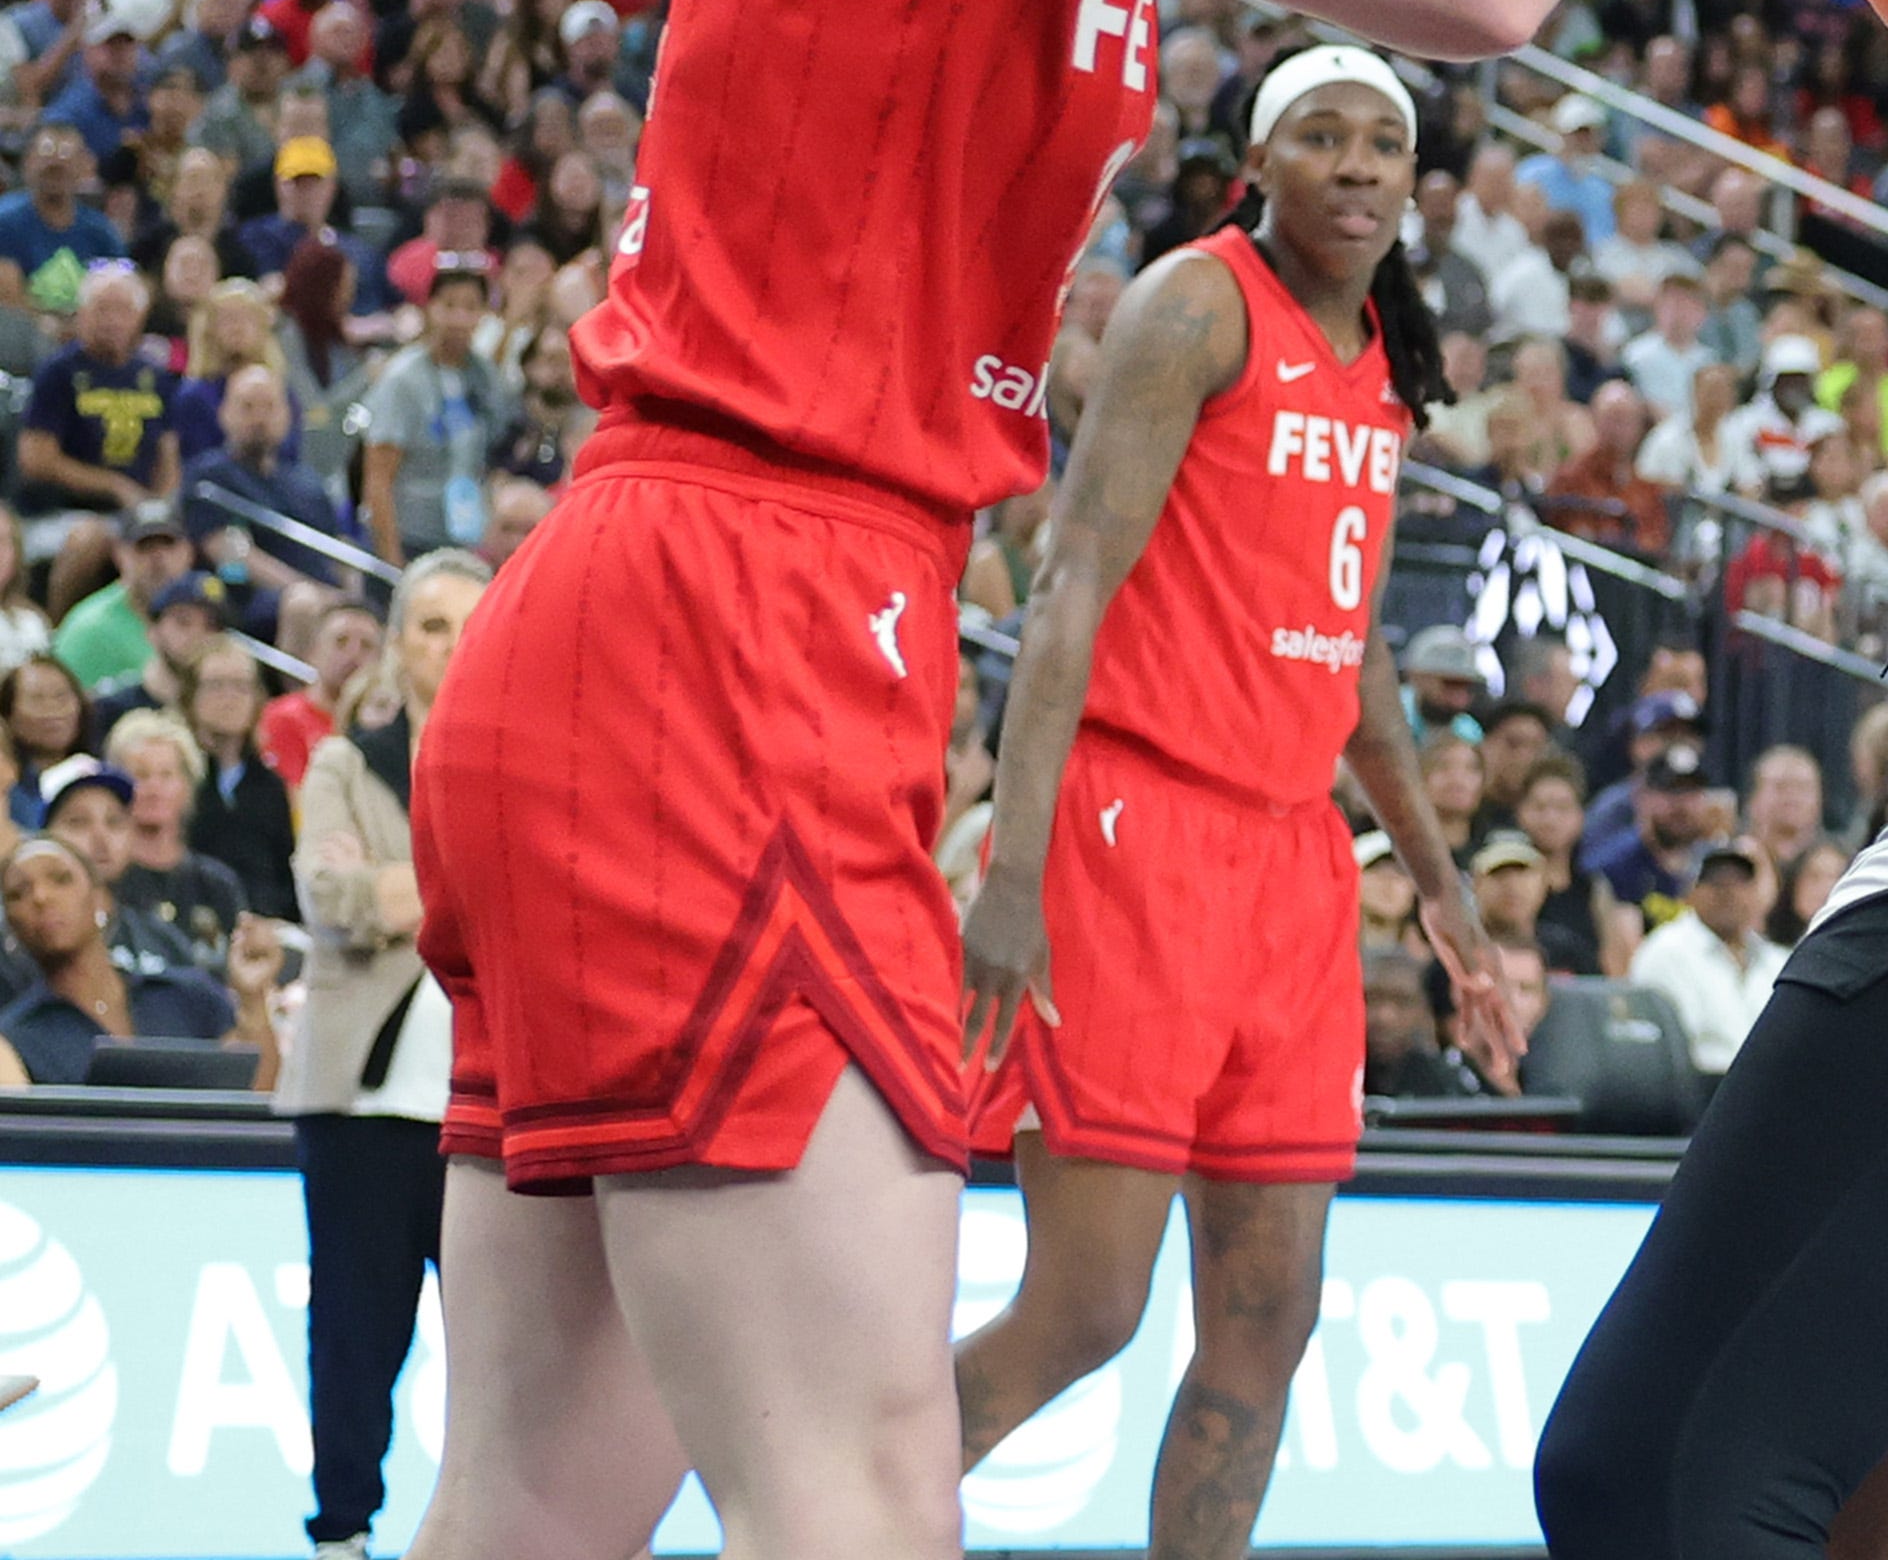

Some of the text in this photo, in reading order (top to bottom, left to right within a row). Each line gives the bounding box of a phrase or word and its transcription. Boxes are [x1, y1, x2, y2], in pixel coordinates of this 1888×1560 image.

[970, 354, 1048, 420] sal
[1267, 409, 1400, 497] FEVE
[1328, 504, 1367, 611] 6
